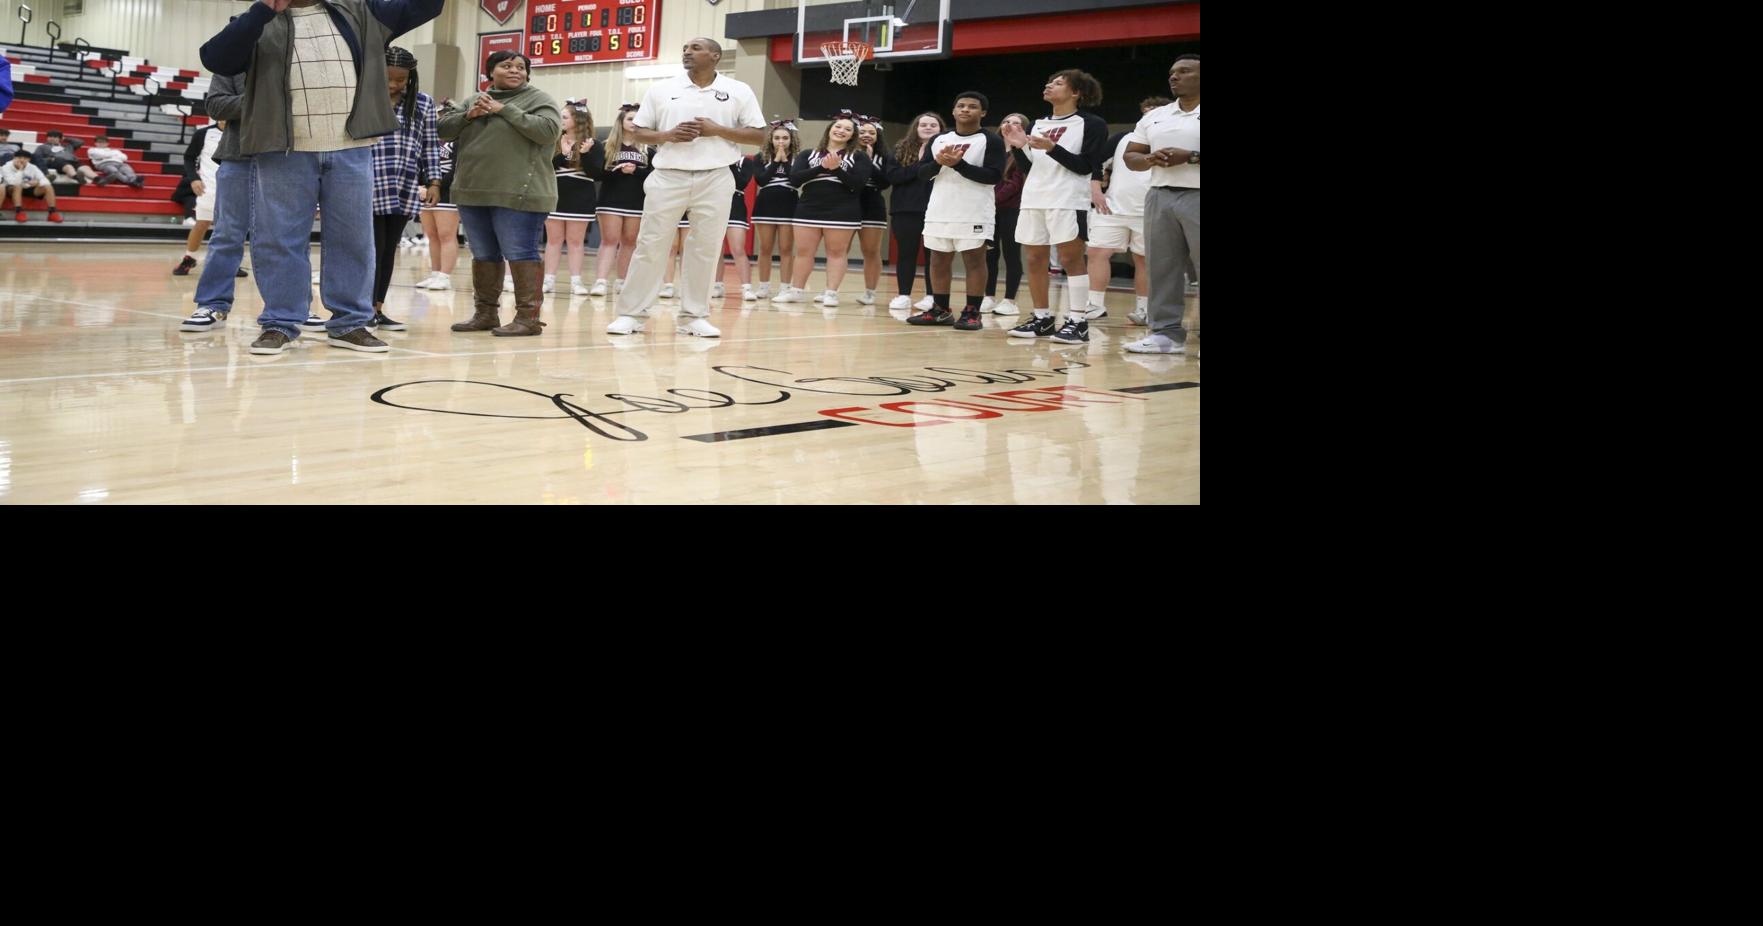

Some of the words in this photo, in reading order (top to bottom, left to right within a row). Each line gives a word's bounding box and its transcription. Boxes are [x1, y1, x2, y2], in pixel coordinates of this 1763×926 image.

[535, 4, 557, 14] HOME
[568, 31, 588, 39] PLAYER
[817, 385, 1150, 428] COURT
